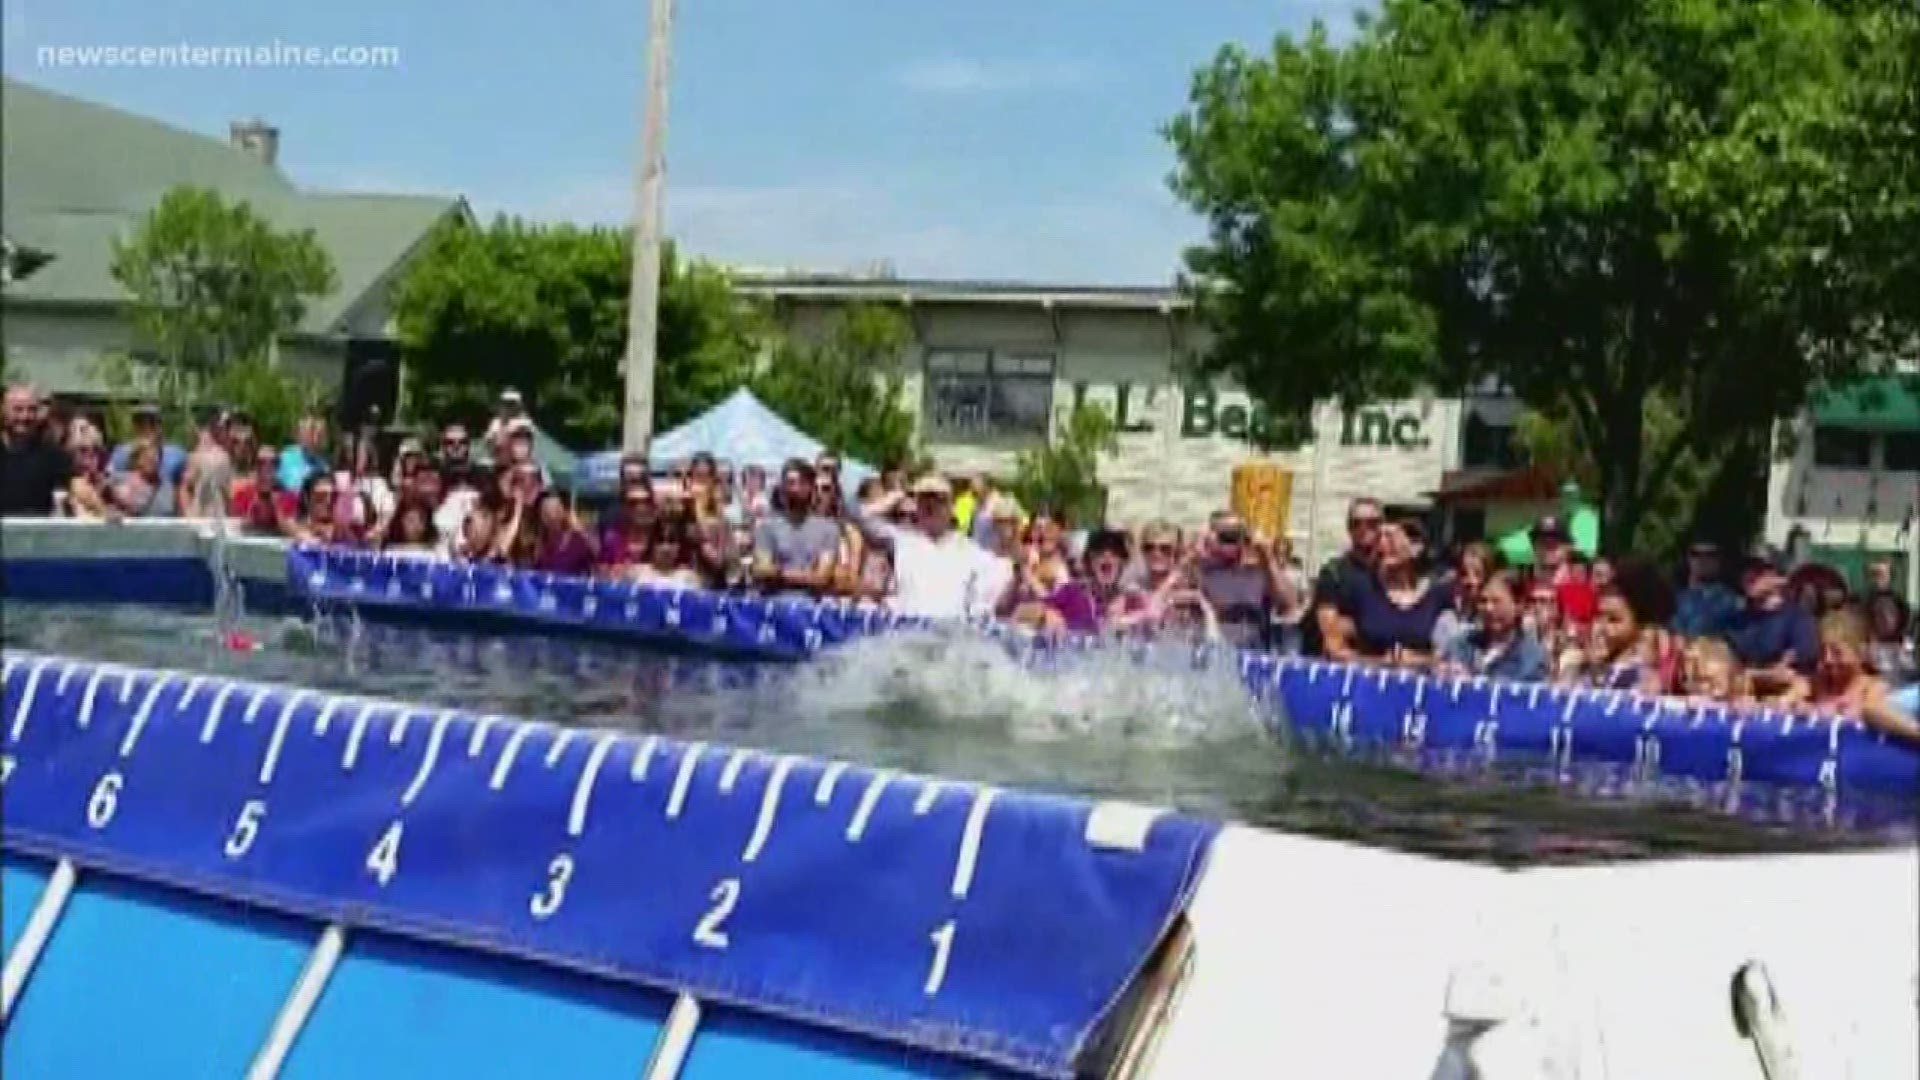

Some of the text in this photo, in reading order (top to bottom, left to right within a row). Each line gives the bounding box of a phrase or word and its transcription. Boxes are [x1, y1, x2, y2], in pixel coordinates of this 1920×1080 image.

[1181, 383, 1286, 441] Bea
[1340, 401, 1429, 446] Inc.
[87, 772, 122, 828] 6
[225, 801, 266, 858] 5
[366, 820, 403, 886] 4
[530, 853, 575, 918] 3
[693, 878, 741, 949] 2
[923, 919, 957, 995] 1
